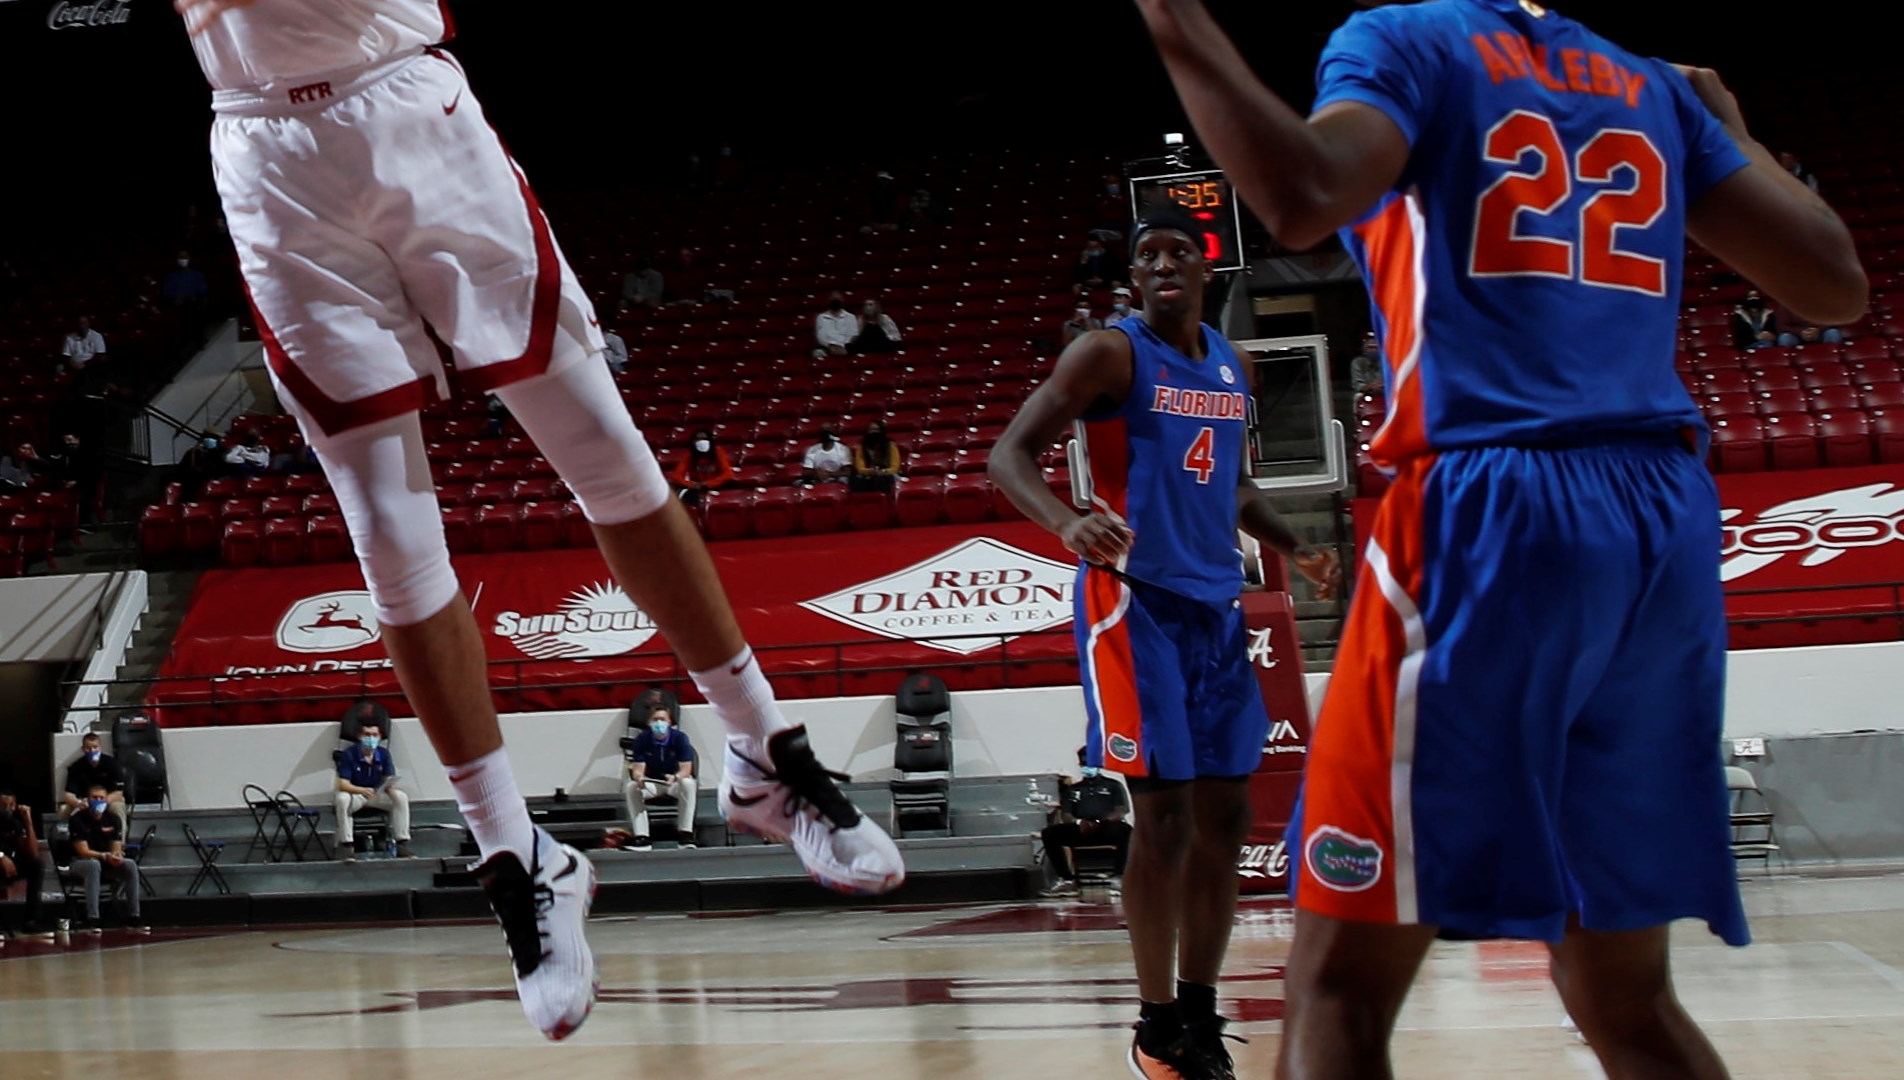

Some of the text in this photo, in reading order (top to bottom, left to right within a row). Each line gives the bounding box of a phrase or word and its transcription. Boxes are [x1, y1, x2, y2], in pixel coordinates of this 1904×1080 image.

[288, 81, 334, 105] RTR
[1468, 108, 1667, 298] 22
[1149, 384, 1245, 421] FLORIDA
[1183, 426, 1215, 485] 4
[928, 568, 1034, 589] RED
[851, 582, 1076, 615] DIAMON
[884, 613, 976, 629] COFFEE
[1011, 609, 1055, 621] TEA
